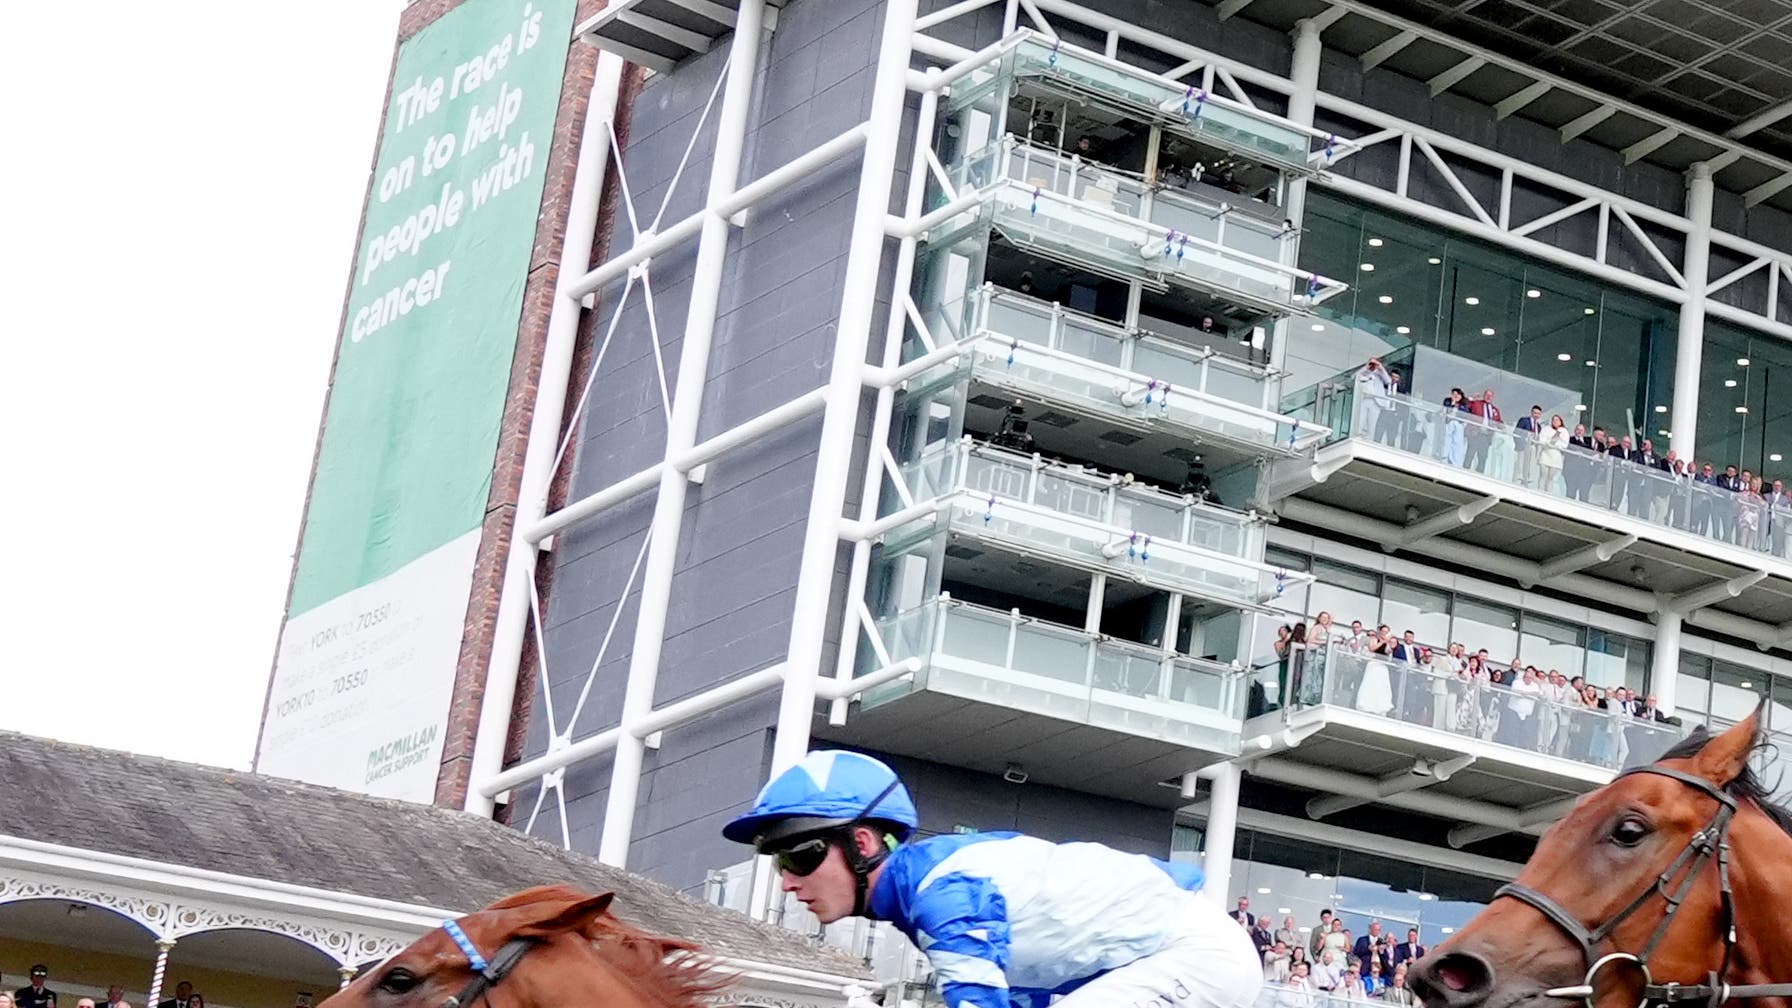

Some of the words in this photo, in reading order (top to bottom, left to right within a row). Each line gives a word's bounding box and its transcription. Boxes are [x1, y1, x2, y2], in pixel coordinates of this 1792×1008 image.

[396, 75, 444, 134] The
[449, 33, 512, 101] race
[517, 2, 543, 55] is
[379, 155, 415, 203] on
[422, 132, 455, 177] to
[461, 82, 522, 157] help
[362, 182, 464, 286] people
[472, 131, 534, 211] with
[352, 261, 451, 343] cancer
[311, 627, 338, 651] YORK
[331, 668, 368, 696] 70550
[365, 762, 392, 784] CANCER
[394, 747, 429, 773] SUPPORT
[367, 724, 437, 770] MACMILLAN
